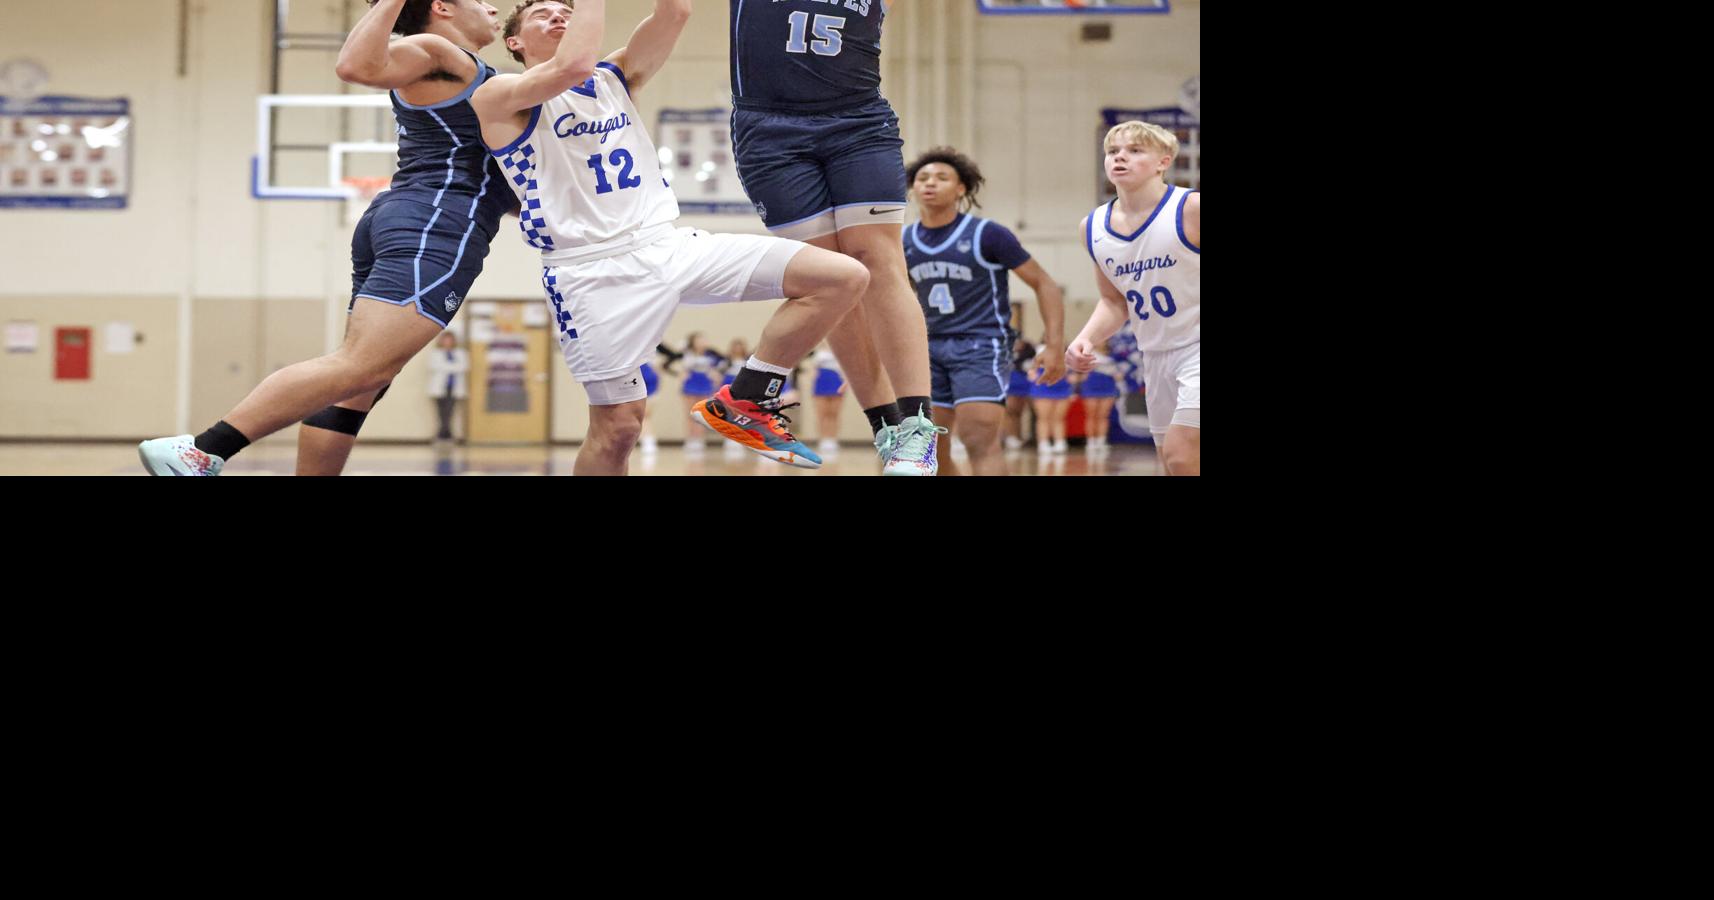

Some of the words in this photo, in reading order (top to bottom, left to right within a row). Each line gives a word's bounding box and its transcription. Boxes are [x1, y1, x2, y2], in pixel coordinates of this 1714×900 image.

[786, 10, 846, 56] 15
[587, 148, 641, 194] 12
[928, 283, 955, 314] 4
[1126, 286, 1177, 320] 20
